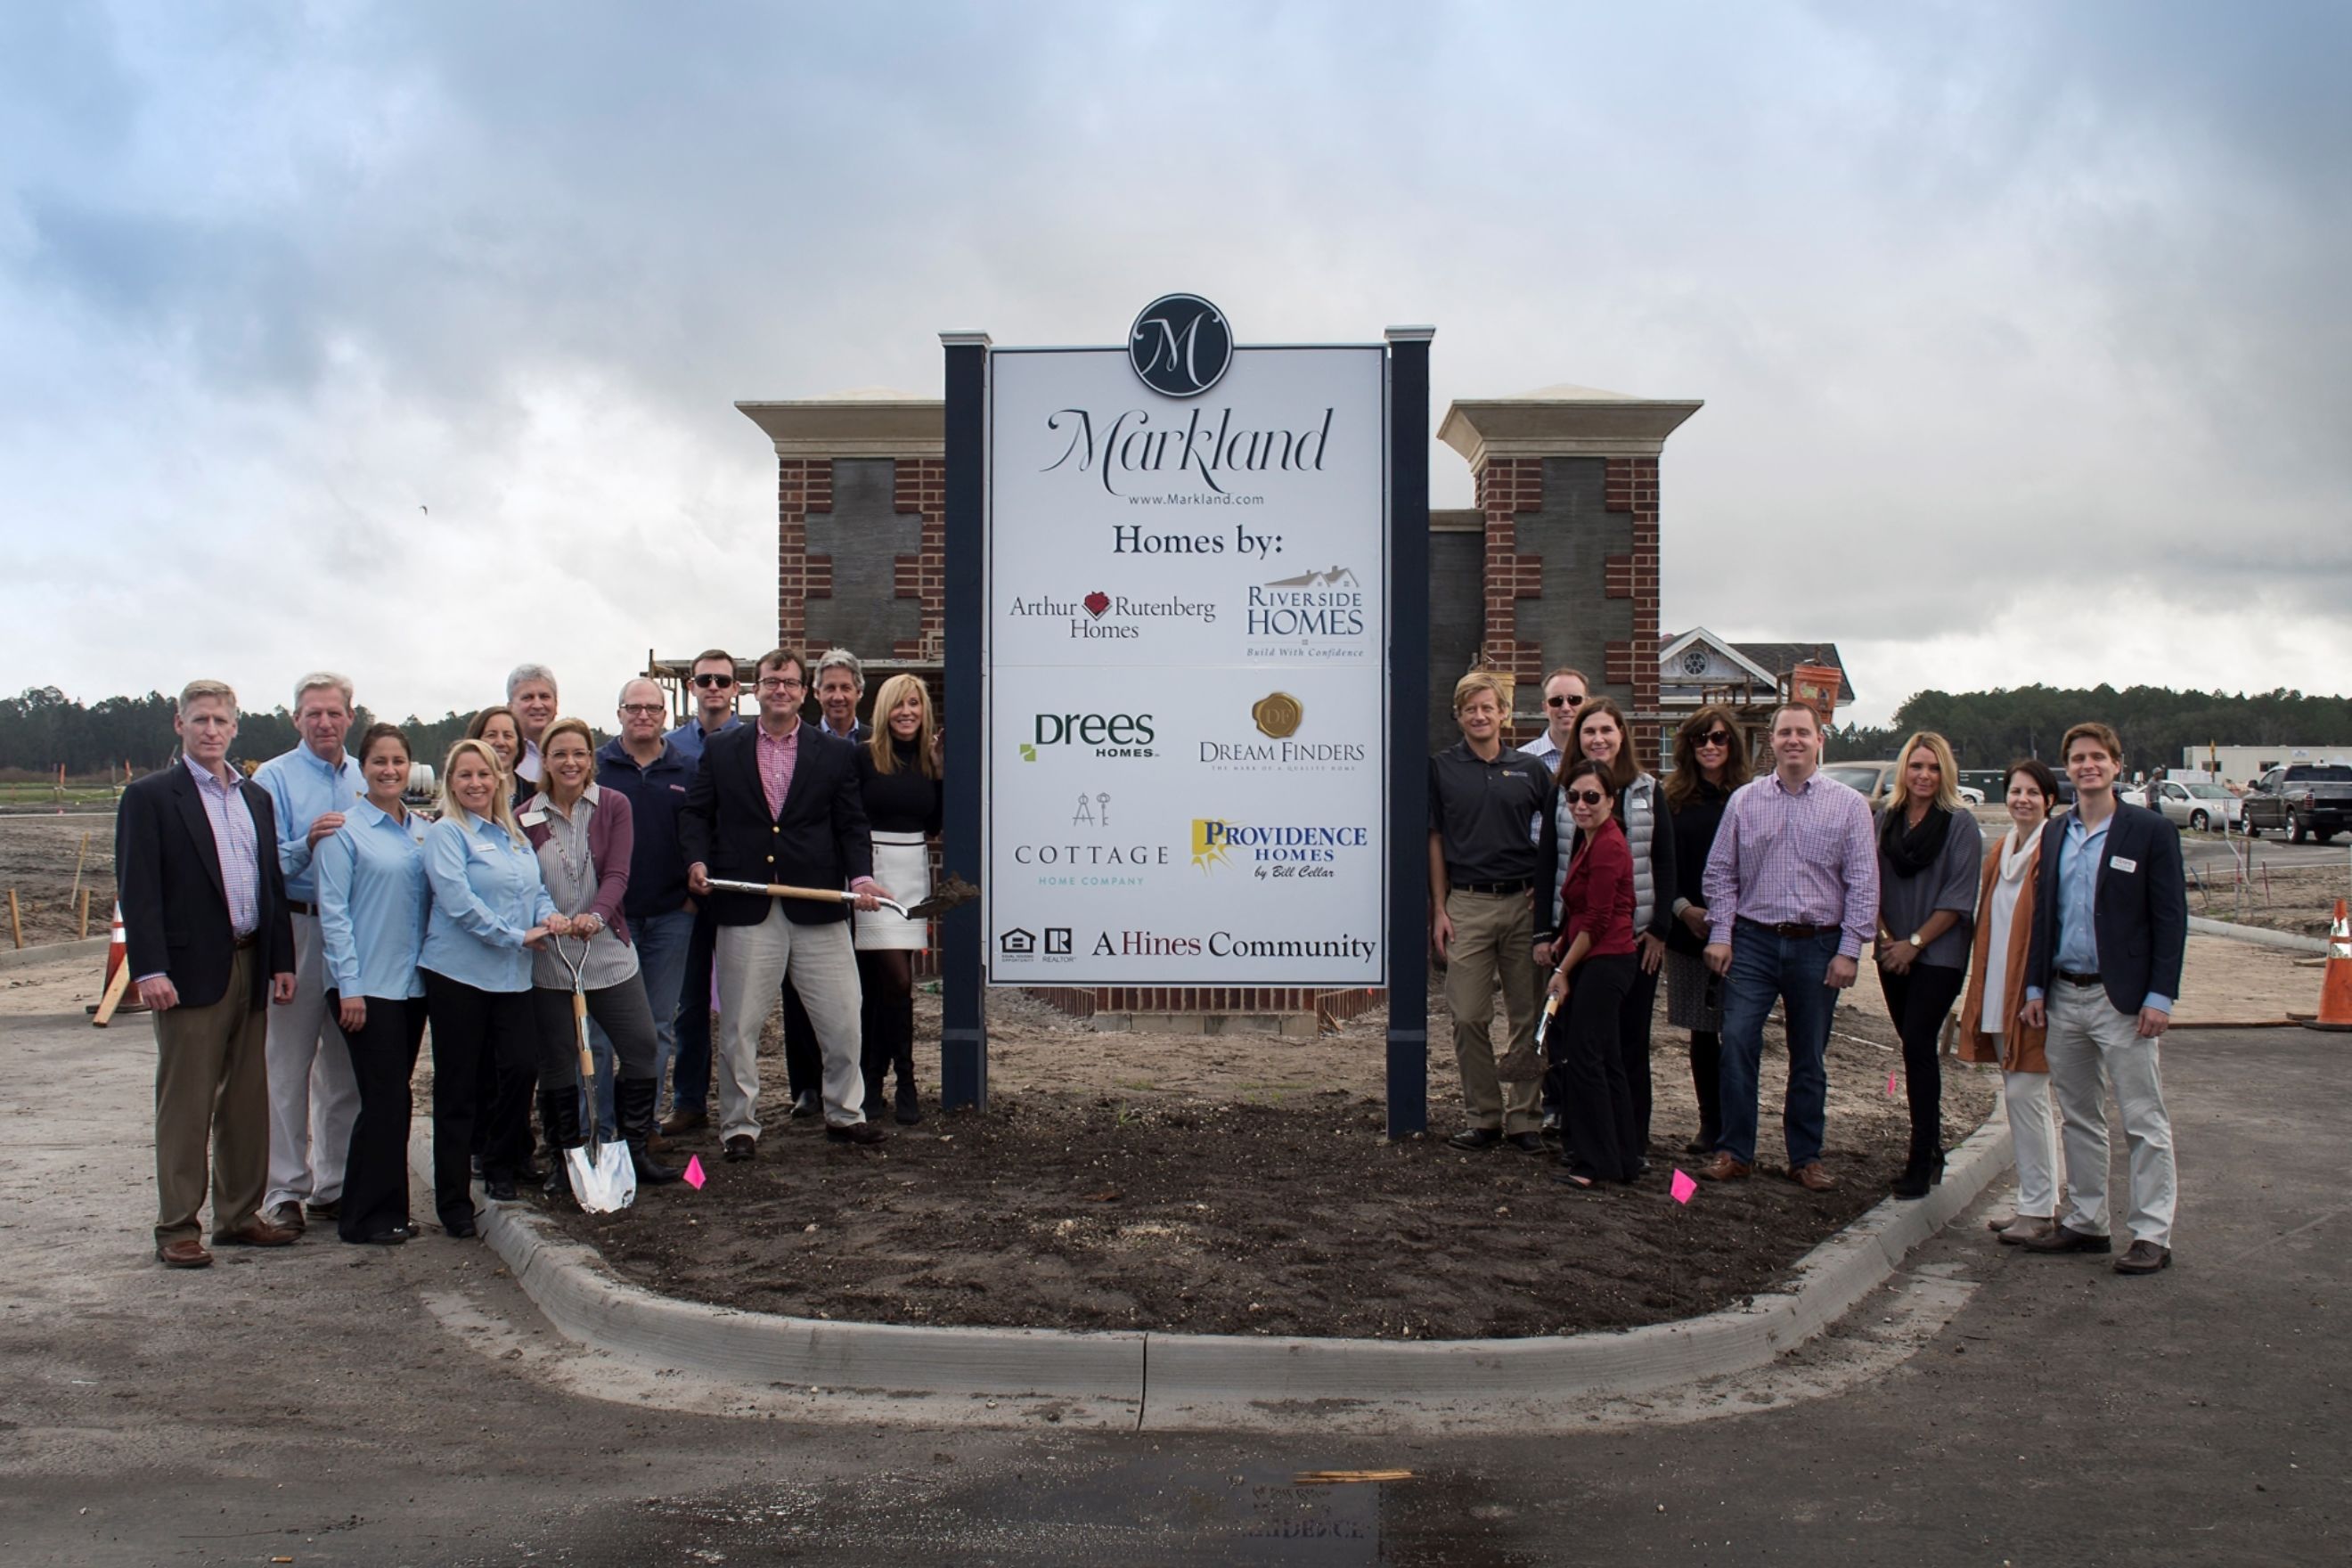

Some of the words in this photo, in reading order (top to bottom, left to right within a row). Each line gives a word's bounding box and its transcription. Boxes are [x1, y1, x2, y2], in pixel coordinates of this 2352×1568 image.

[1039, 407, 1334, 497] Markland
[1129, 493, 1264, 505] www.Markland.com
[1112, 525, 1224, 554] Homes
[1237, 524, 1283, 559] by:
[1248, 586, 1362, 607] RIVERSIDE
[1009, 596, 1078, 617] Arthur
[1115, 596, 1216, 623] Rutenberg
[1070, 619, 1139, 639] Homes
[1247, 609, 1364, 635] HOMES
[1247, 648, 1275, 657] Build
[1280, 648, 1303, 657] With
[1308, 648, 1364, 659] Confidence
[1035, 714, 1155, 746] Drees
[1096, 748, 1154, 757] HOMES
[1199, 741, 1275, 764] DREAM
[1281, 741, 1365, 764] FINDERS
[1205, 821, 1368, 846] PROVIDENCE
[1015, 845, 1168, 864] COTTAGE
[1254, 849, 1335, 862] HOMES
[1039, 877, 1075, 886] HOME
[1082, 877, 1144, 886] COMPANY
[1254, 866, 1267, 880] by
[1272, 865, 1295, 878] Bill
[1298, 865, 1335, 878] Cellar
[1092, 931, 1116, 956] A
[1121, 931, 1202, 956] Hines
[1209, 931, 1376, 964] Community
